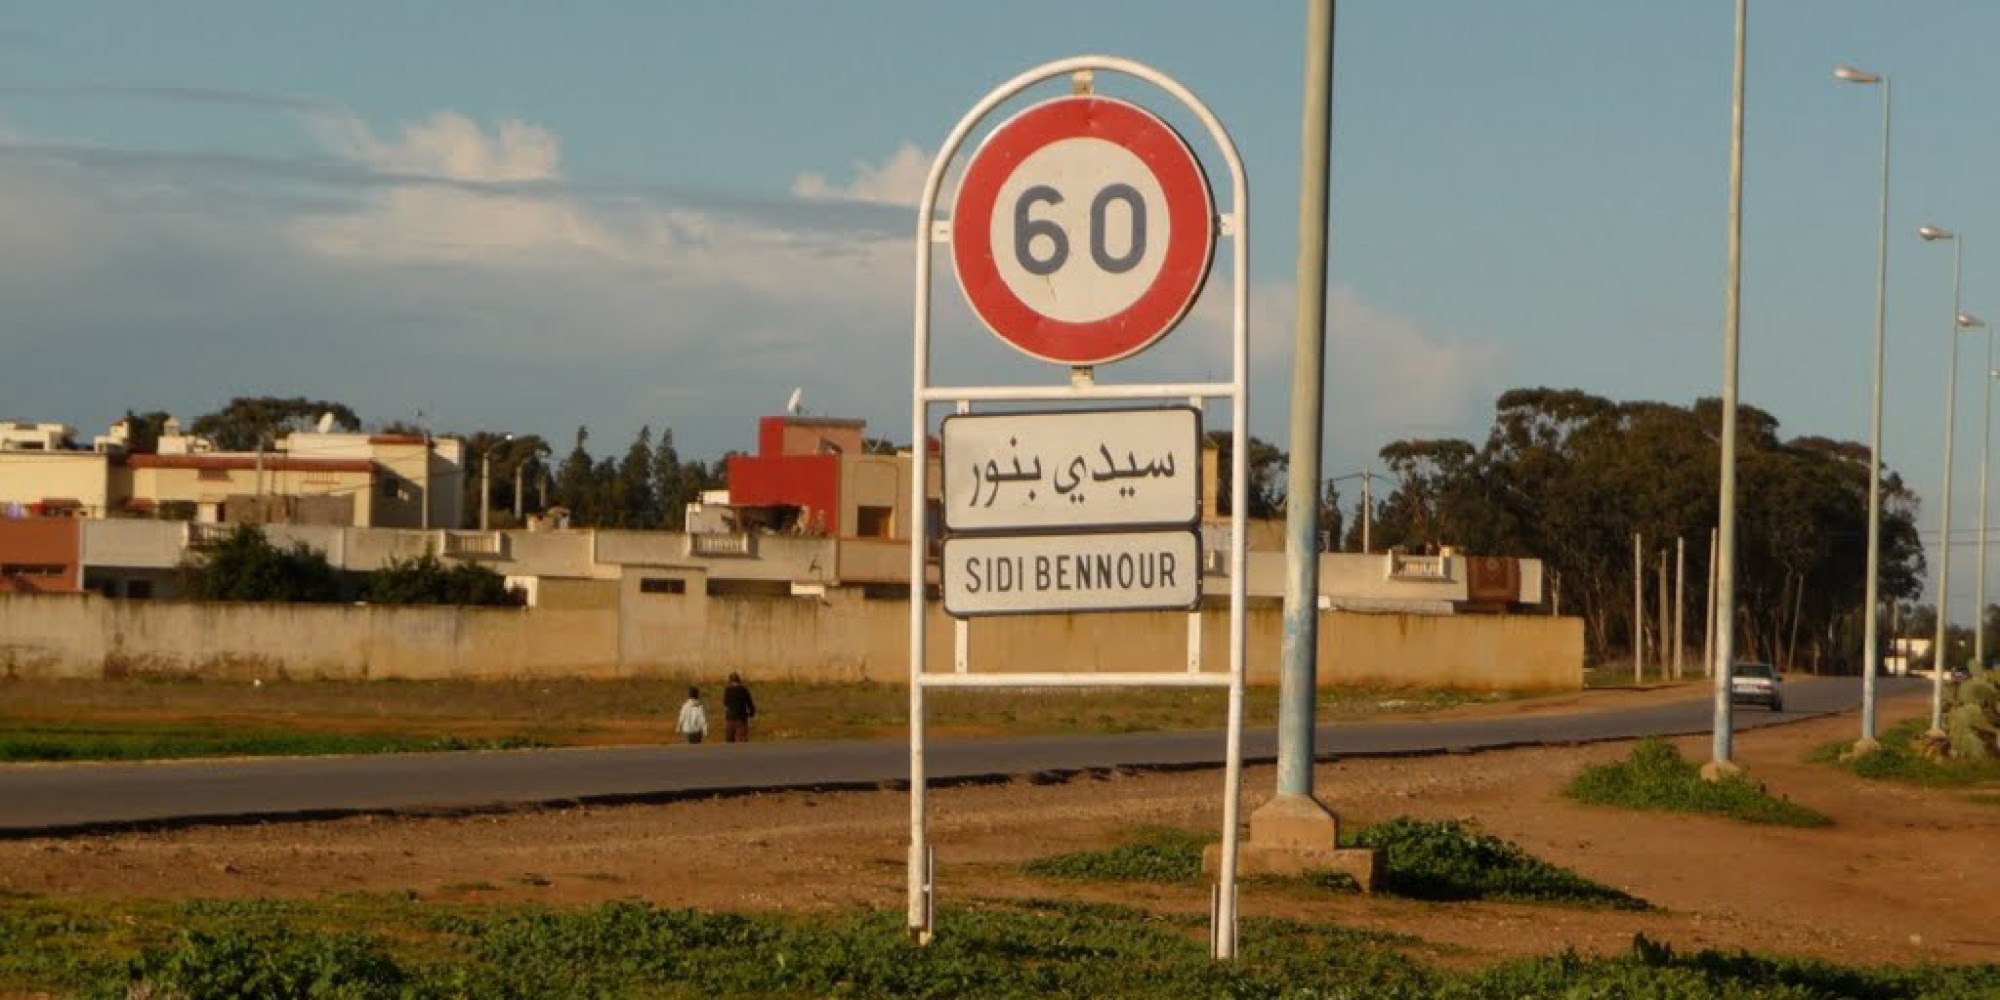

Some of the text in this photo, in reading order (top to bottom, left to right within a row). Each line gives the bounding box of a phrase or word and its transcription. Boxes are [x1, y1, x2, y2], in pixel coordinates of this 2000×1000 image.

[1014, 183, 1147, 276] 60
[969, 436, 1176, 508] سيدي بنور
[965, 552, 1177, 594] SIDI BENNOUR
